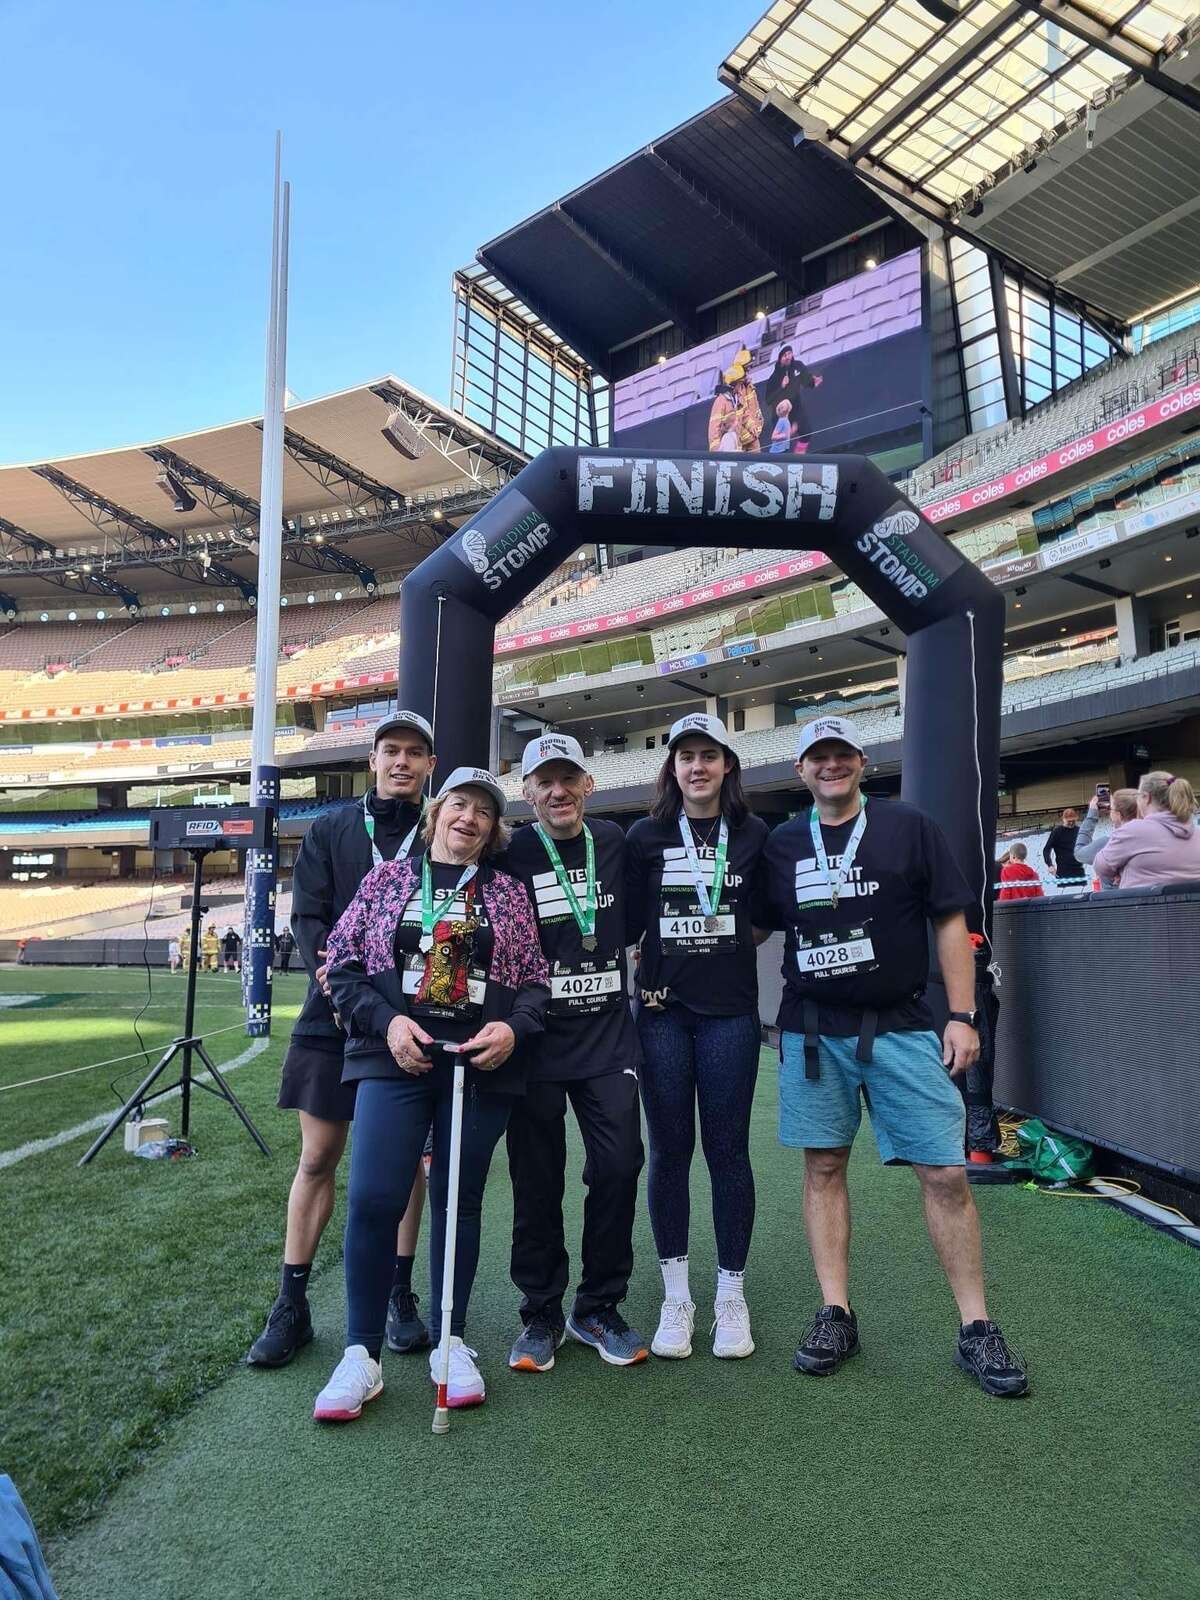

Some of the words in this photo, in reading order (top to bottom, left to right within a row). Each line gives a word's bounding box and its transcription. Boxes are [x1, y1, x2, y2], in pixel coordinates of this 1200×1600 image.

[929, 500, 961, 520] coles
[972, 482, 1005, 504] coles
[1015, 461, 1048, 486] coles
[1059, 439, 1095, 465] coles
[1107, 413, 1145, 441] coles
[1159, 387, 1200, 417] coles
[577, 457, 838, 520] FINISH
[487, 511, 542, 560] STADIUM
[482, 523, 550, 590] STOMP
[887, 535, 939, 588] STADIUM
[857, 533, 928, 598] STOMP
[523, 634, 543, 645] coles
[577, 621, 599, 632] coles
[606, 615, 628, 627] coles
[635, 607, 656, 619] coles
[662, 598, 684, 610] coles
[692, 589, 714, 602] coles
[722, 579, 746, 593] coles
[754, 568, 779, 583] coles
[788, 557, 814, 573] coles
[669, 658, 698, 671] HCLTech
[189, 822, 213, 830] RFID
[724, 875, 743, 888] UP
[848, 867, 863, 881] IT
[857, 881, 879, 896] UP
[599, 894, 614, 908] UP
[670, 920, 711, 935] 410
[807, 947, 848, 968] 4028
[814, 970, 830, 978] FULL
[831, 965, 857, 976] COURSE
[561, 977, 602, 994] 4027
[586, 995, 608, 1004] COURSE
